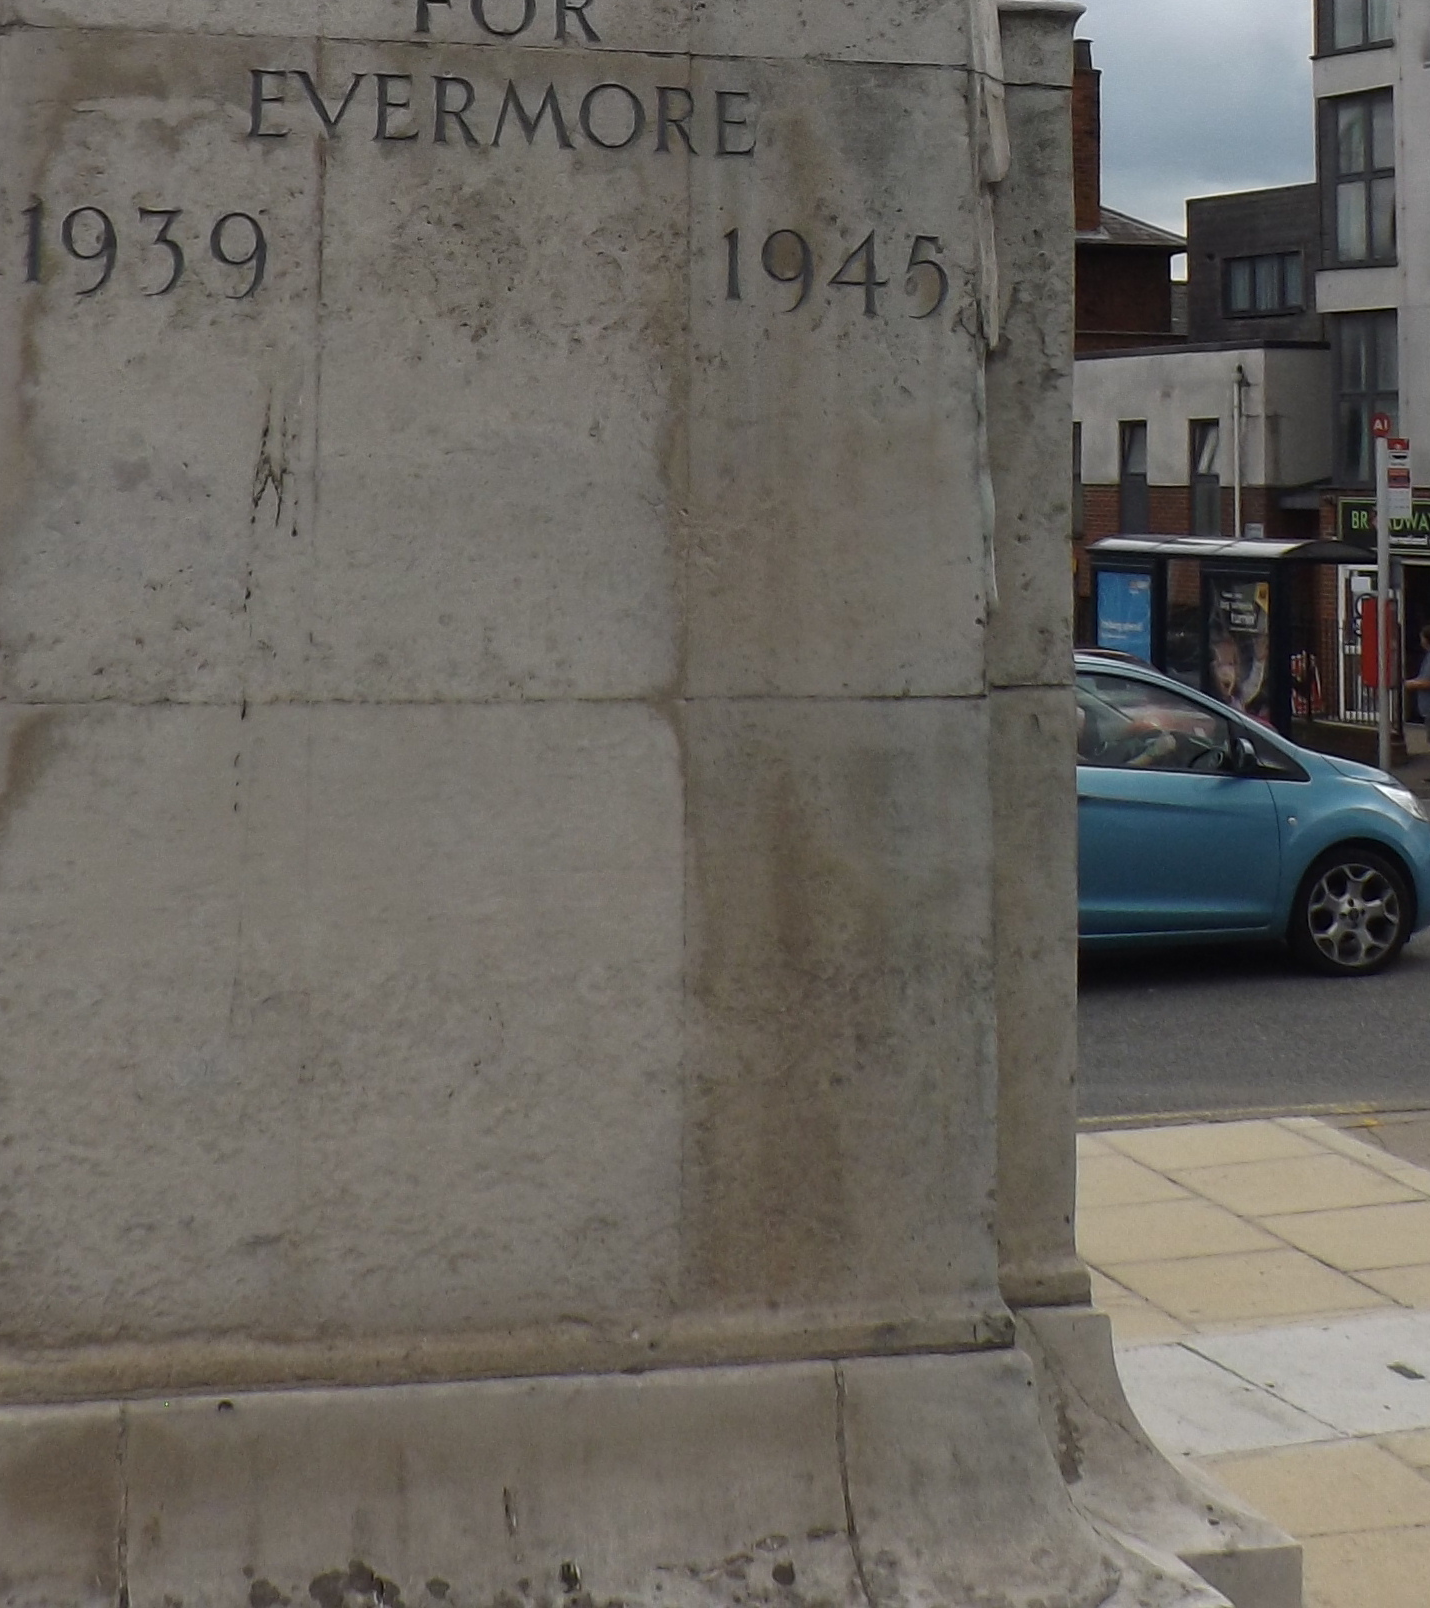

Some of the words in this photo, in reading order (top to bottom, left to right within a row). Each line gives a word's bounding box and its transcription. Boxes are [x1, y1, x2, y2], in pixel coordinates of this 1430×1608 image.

[247, 68, 758, 157] EVERMORE
[22, 197, 269, 299] 1939
[722, 226, 951, 320] 1945
